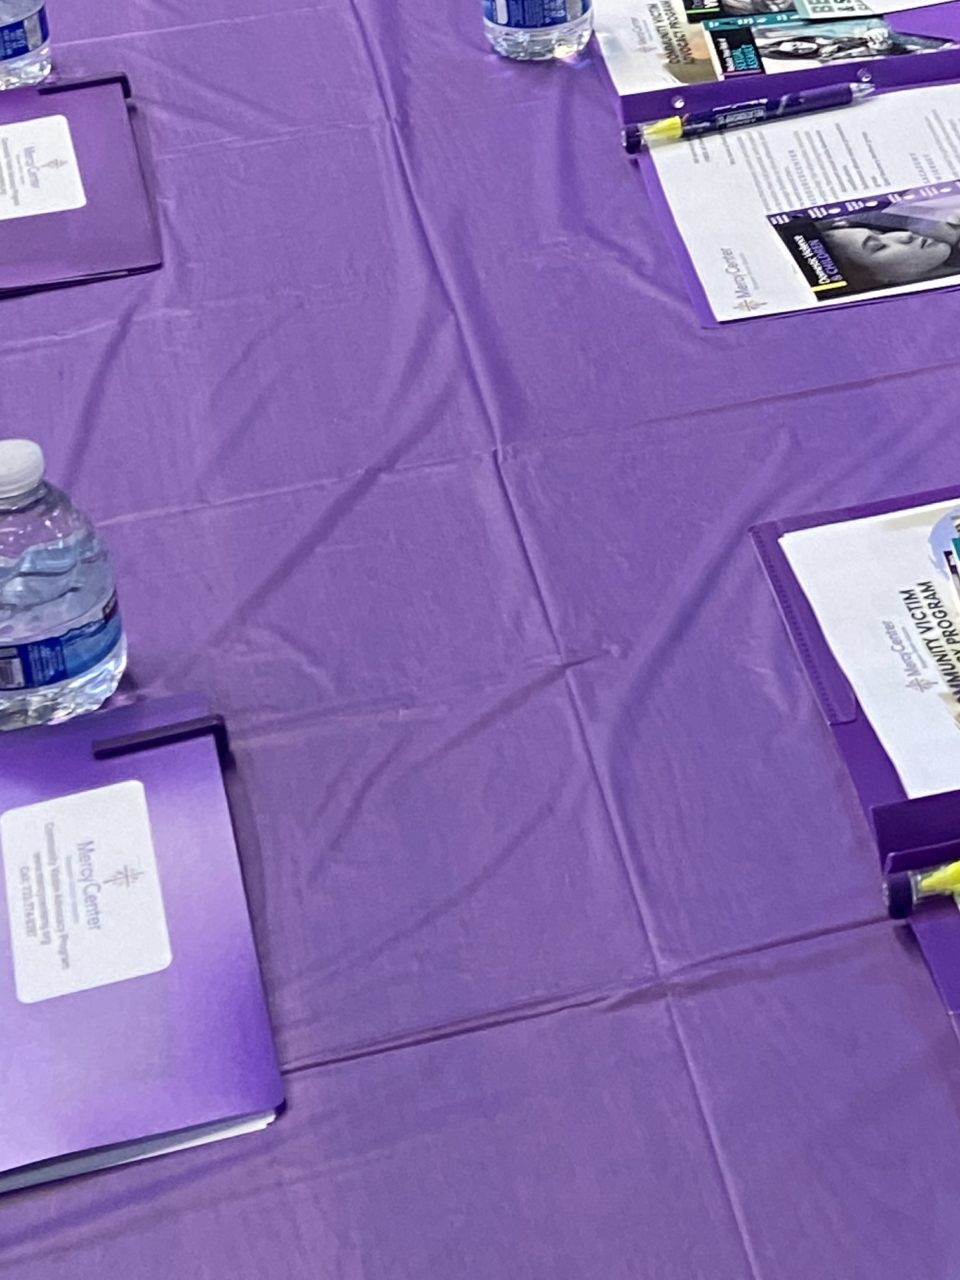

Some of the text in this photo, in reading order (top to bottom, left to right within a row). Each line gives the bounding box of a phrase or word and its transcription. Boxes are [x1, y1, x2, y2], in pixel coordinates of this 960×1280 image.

[655, 25, 680, 64] COMMUNITY
[808, 239, 838, 275] CHILDREN
[898, 588, 932, 633] VICTIM
[58, 934, 70, 969] Program
